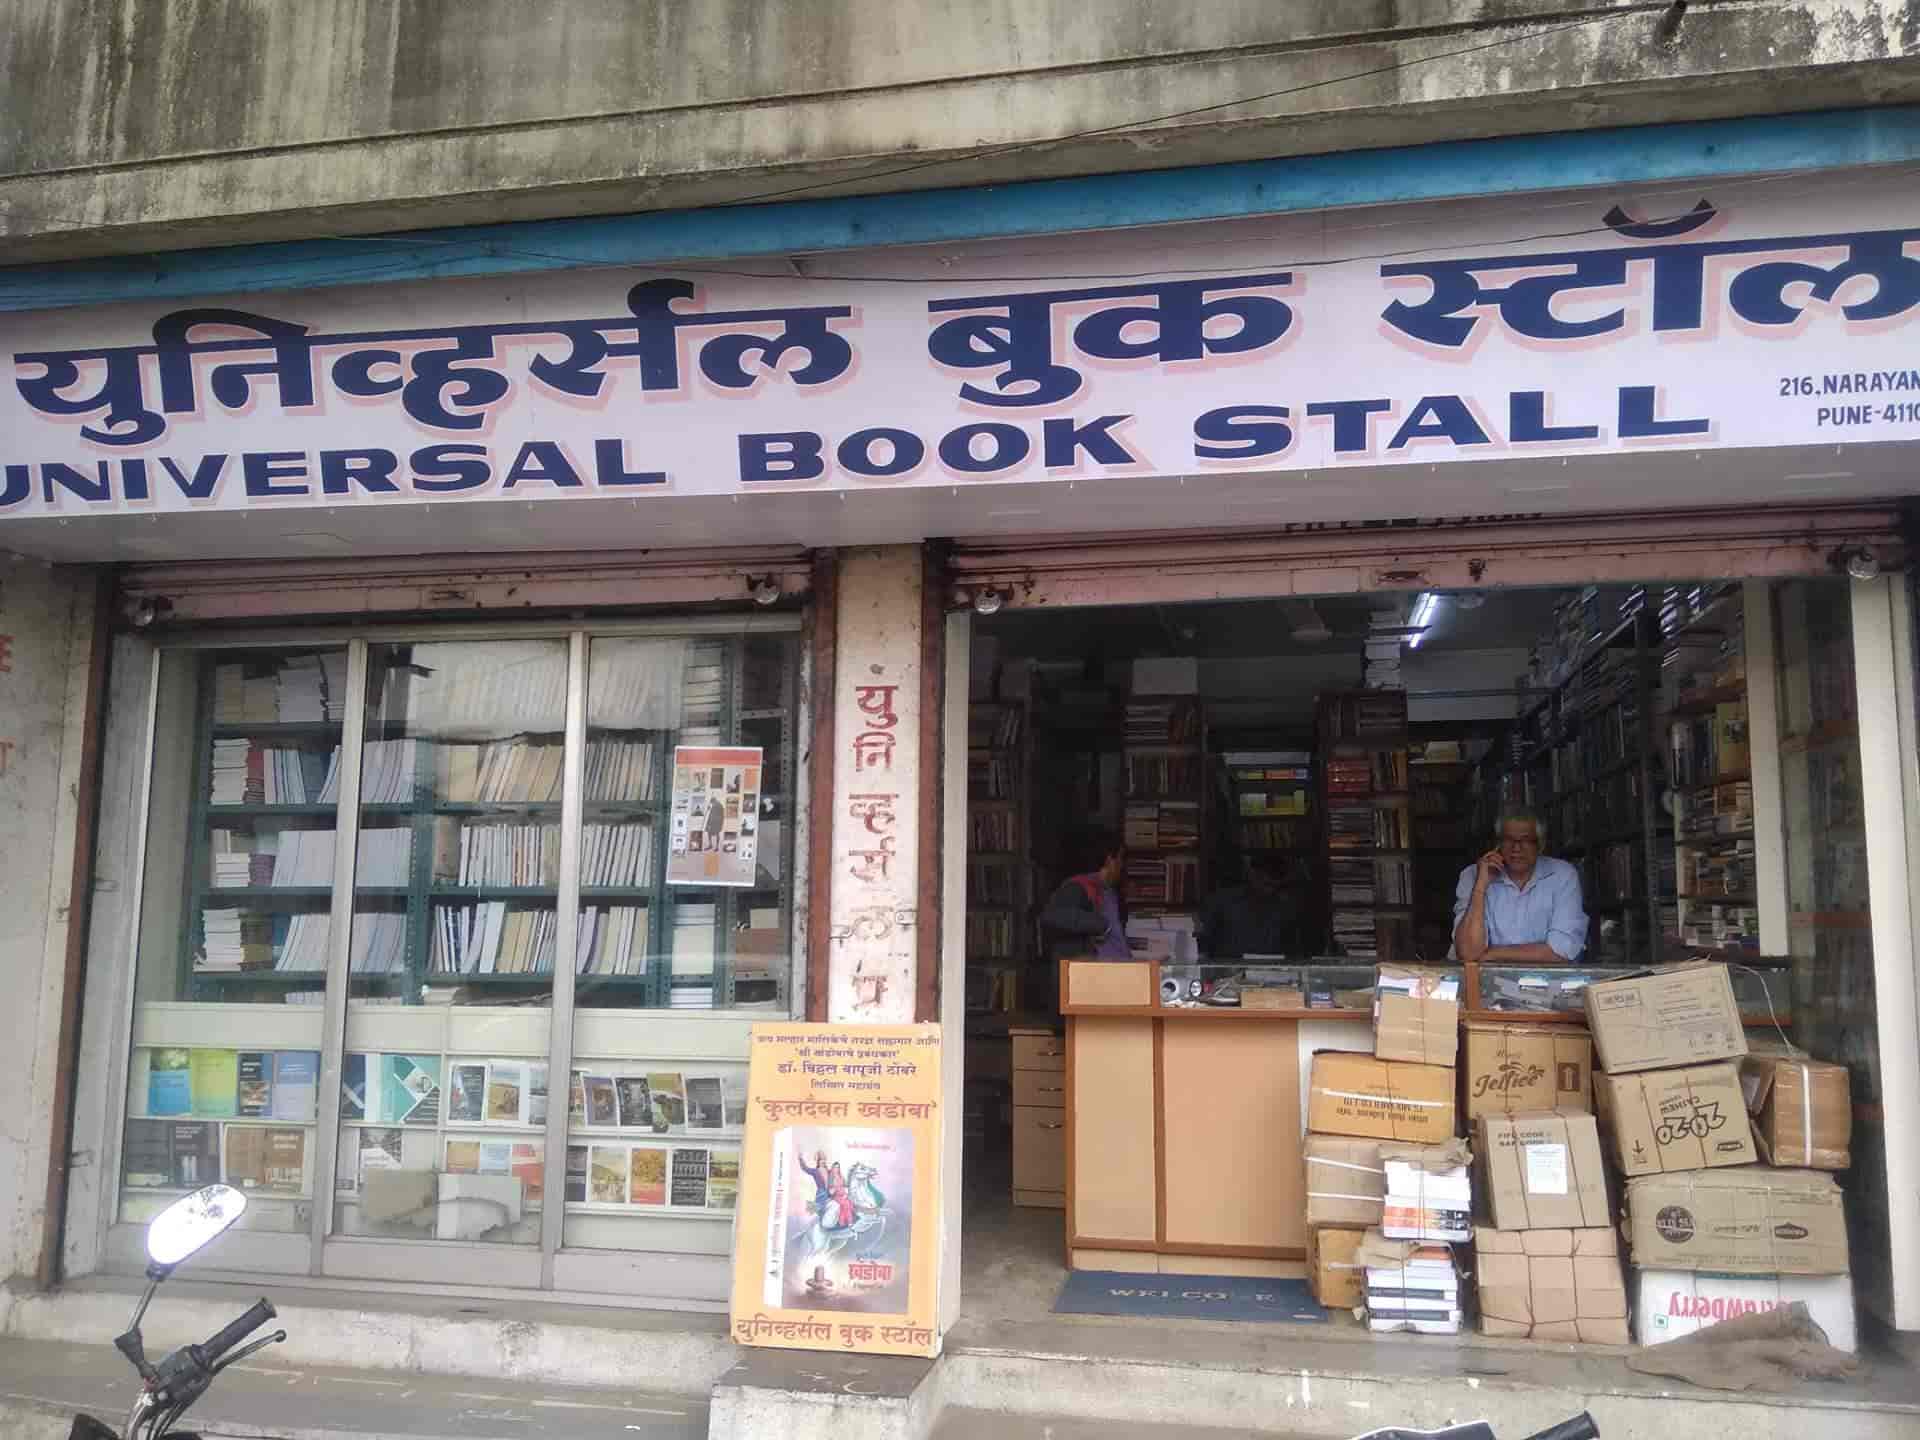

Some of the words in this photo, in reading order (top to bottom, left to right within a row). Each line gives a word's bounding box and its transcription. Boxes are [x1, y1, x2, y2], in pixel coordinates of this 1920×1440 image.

[13, 278, 852, 446] युनिव्हर्सल
[927, 272, 1293, 407] बुक
[1381, 199, 1920, 348] स्टॉल
[738, 414, 1138, 483] BOOK
[1193, 385, 1711, 460] STALL
[839, 1324, 874, 1347] बुक
